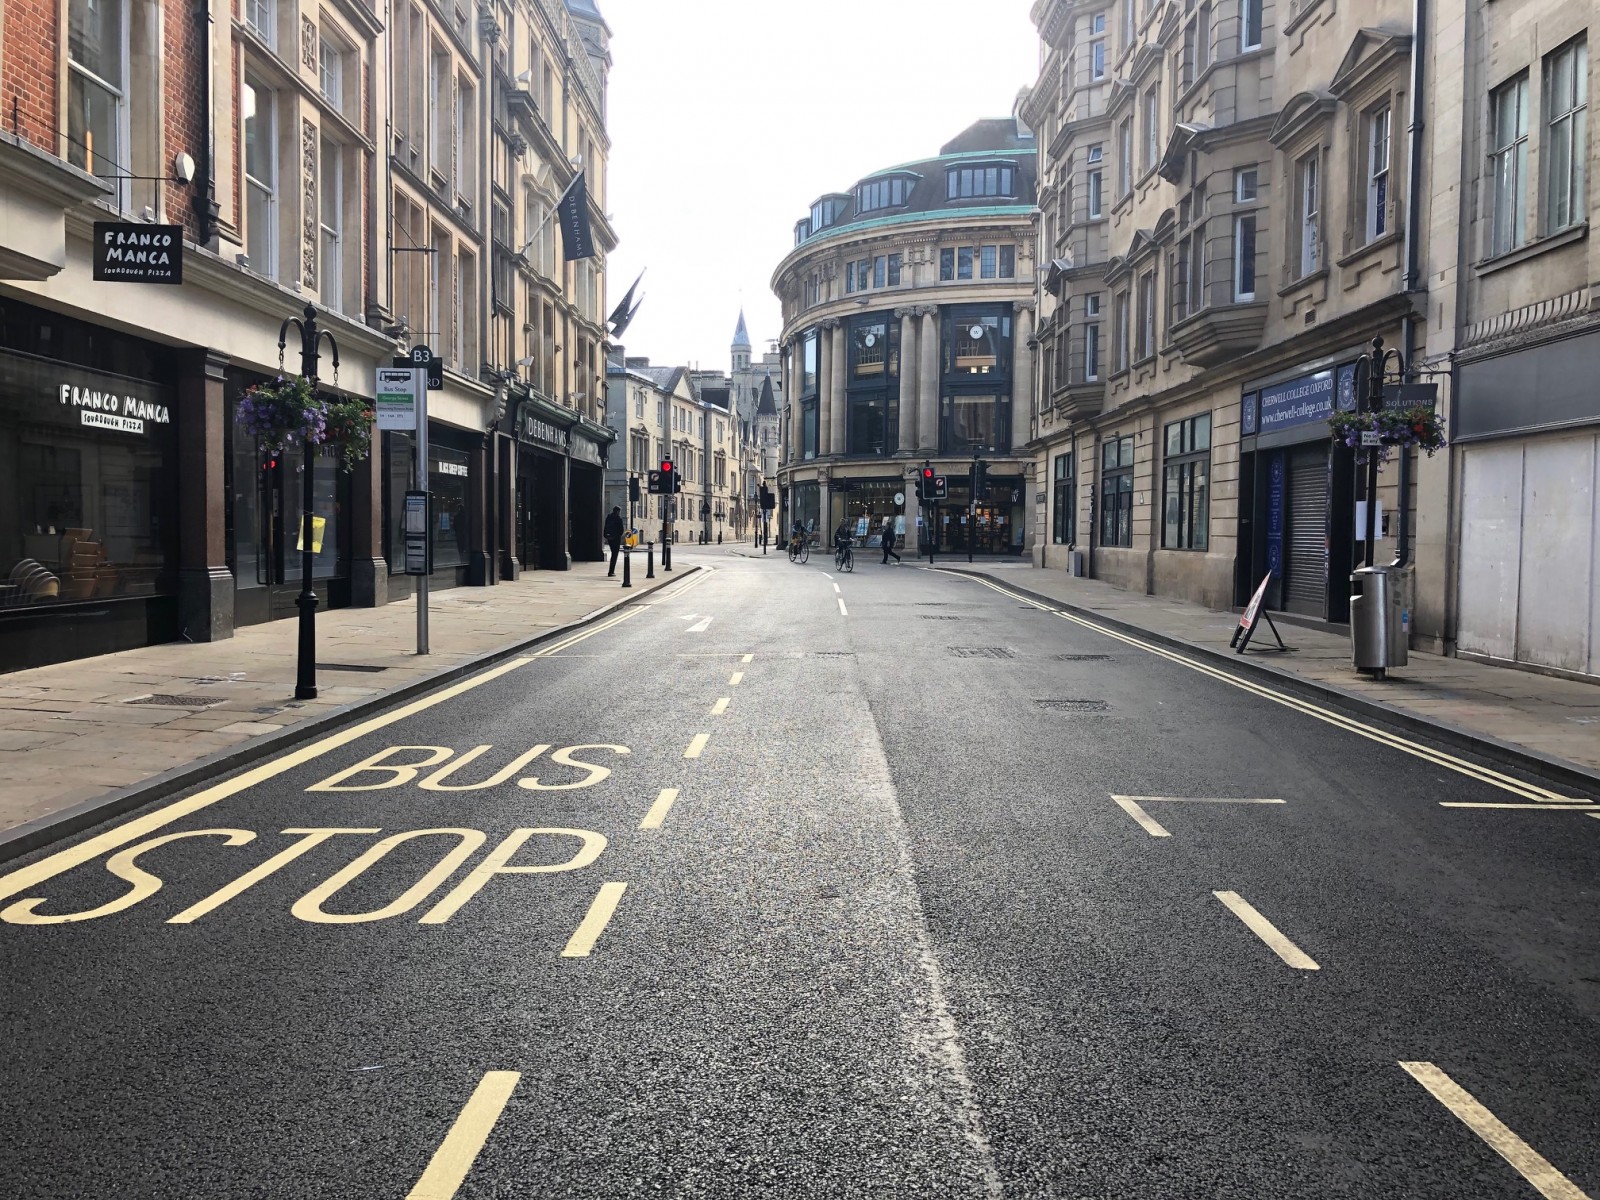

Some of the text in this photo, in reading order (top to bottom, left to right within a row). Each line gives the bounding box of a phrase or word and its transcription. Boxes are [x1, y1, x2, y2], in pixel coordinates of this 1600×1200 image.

[104, 231, 172, 247] FRANCO
[568, 195, 583, 258] DEBENHAMS
[106, 247, 170, 265] MANCA
[104, 267, 172, 277] SOURDOUGH PIZZA
[413, 350, 430, 362] B3
[60, 384, 170, 424] FRANCO MANCA
[1262, 378, 1333, 408] CHERWELL COLLEGE OXFORD
[1385, 398, 1433, 407] SOLUTIONS
[83, 413, 142, 430] SOURDOUGH PIZZA
[1262, 396, 1332, 425] www.cherwell-college.co.uk
[528, 417, 567, 447] DEBENHAMS
[304, 743, 631, 792] BUS
[0, 827, 608, 926] STOP
